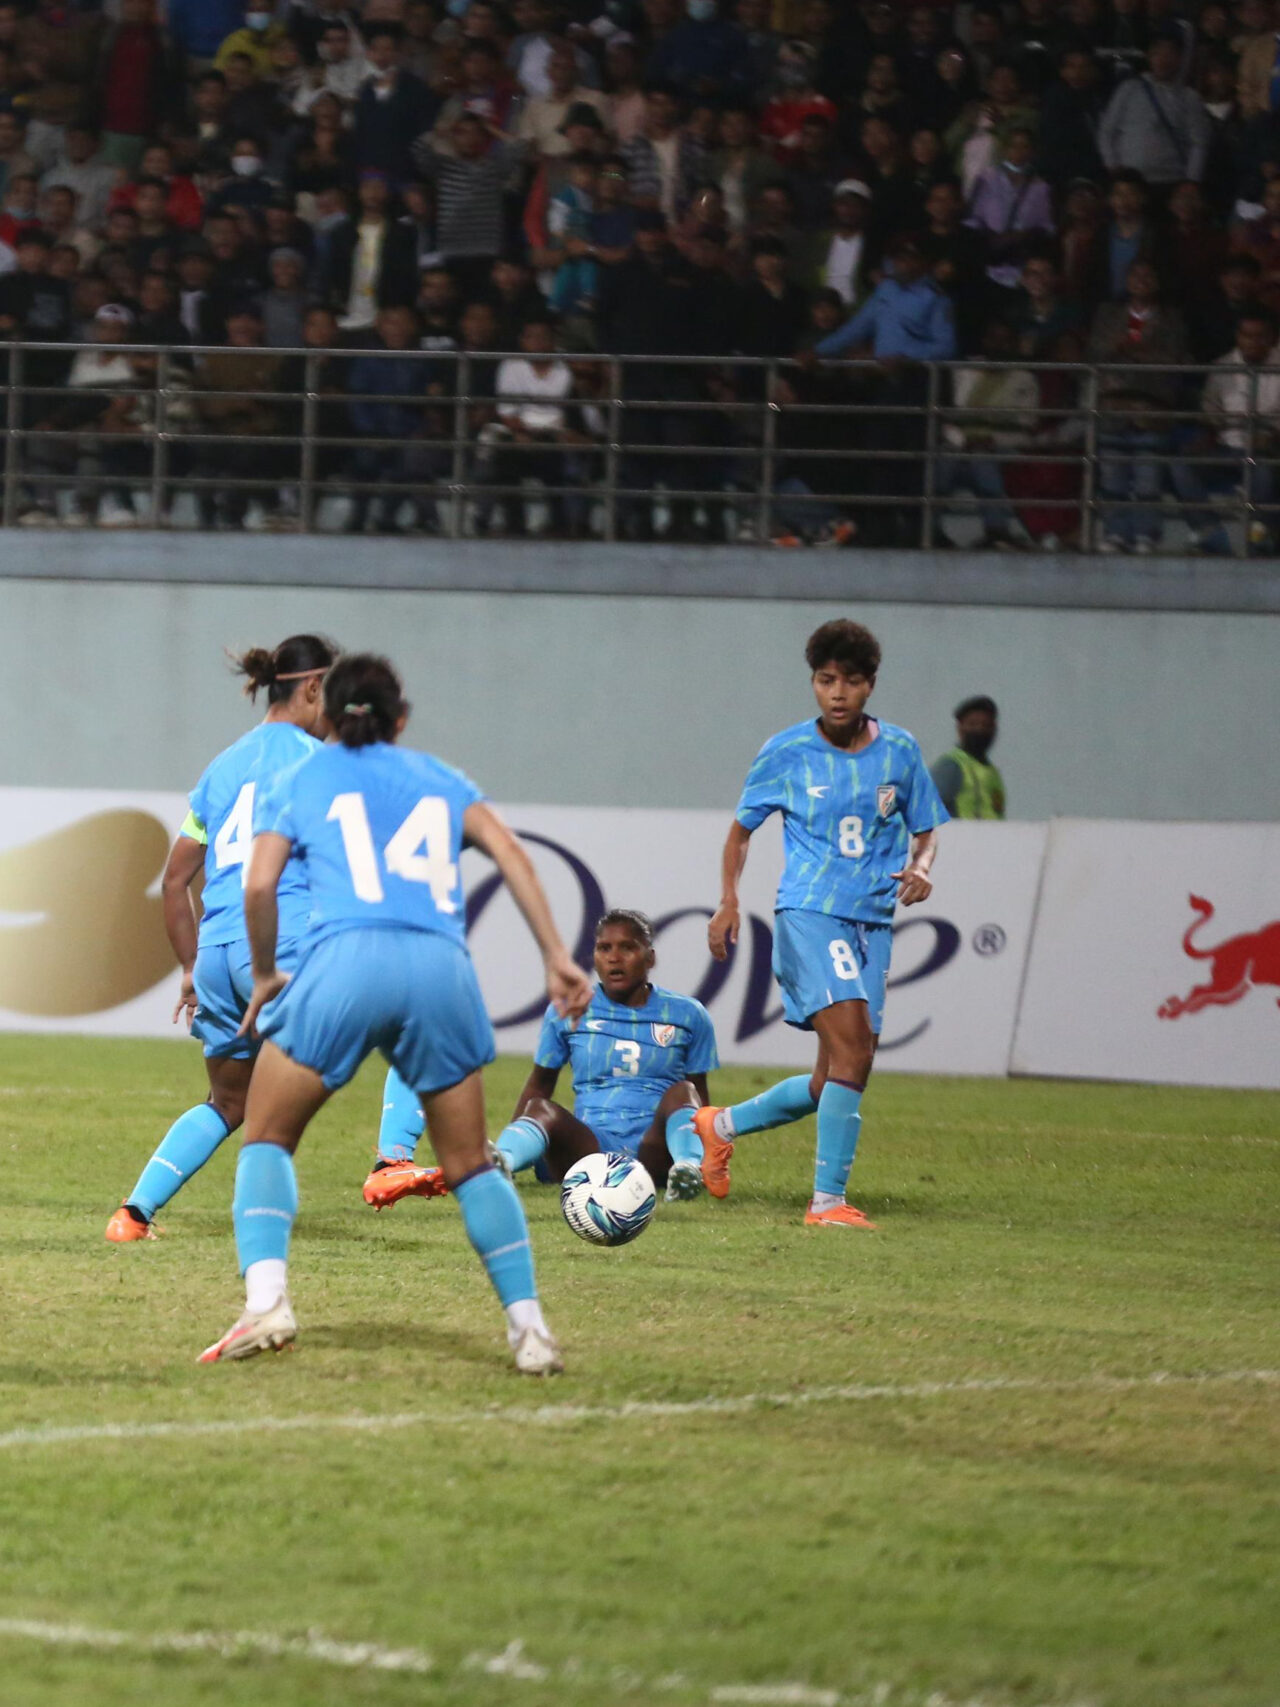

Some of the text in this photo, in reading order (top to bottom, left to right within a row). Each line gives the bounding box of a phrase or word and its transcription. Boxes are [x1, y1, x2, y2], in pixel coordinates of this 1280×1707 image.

[216, 782, 256, 889] 4
[326, 792, 458, 914] 14
[839, 815, 865, 858] 8
[828, 939, 860, 981] 8
[612, 1039, 641, 1078] 3
